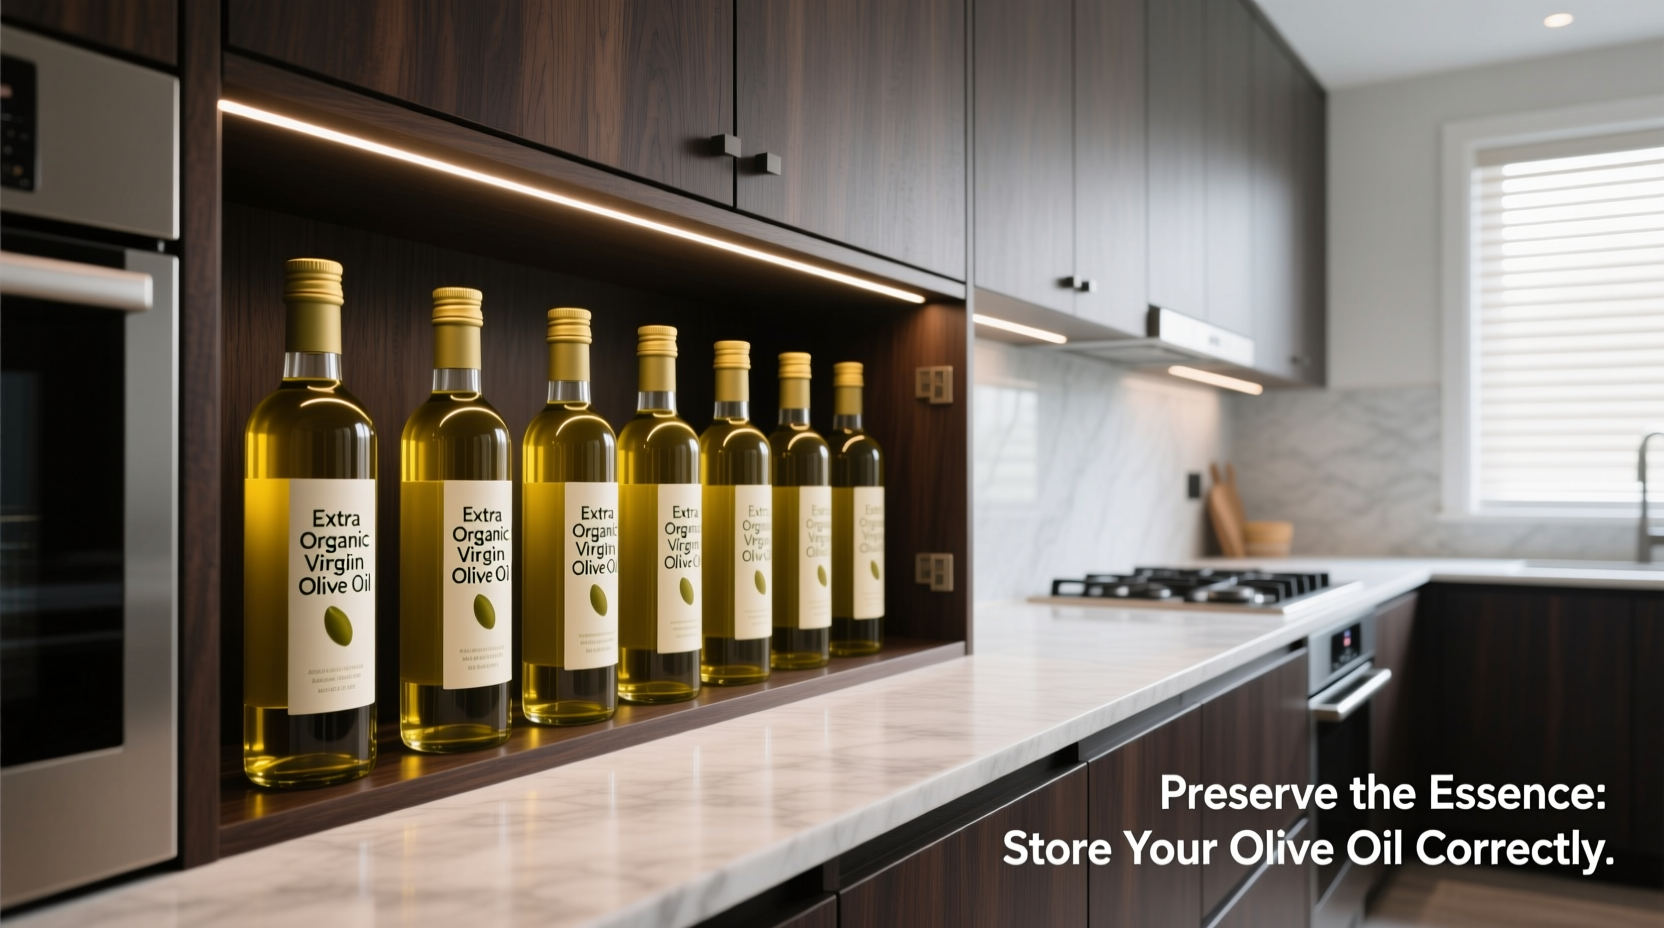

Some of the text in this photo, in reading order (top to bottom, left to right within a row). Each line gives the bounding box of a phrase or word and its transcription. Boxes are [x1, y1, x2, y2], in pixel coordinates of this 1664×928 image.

[313, 509, 360, 528] Extra
[463, 506, 502, 522] Extra
[581, 505, 614, 520] Extra
[300, 530, 370, 554] Organic
[452, 526, 510, 546] Organic
[457, 546, 505, 566] Virgin
[452, 566, 493, 584] Olive
[572, 560, 605, 576] Olive
[298, 573, 371, 596] Olive Oil
